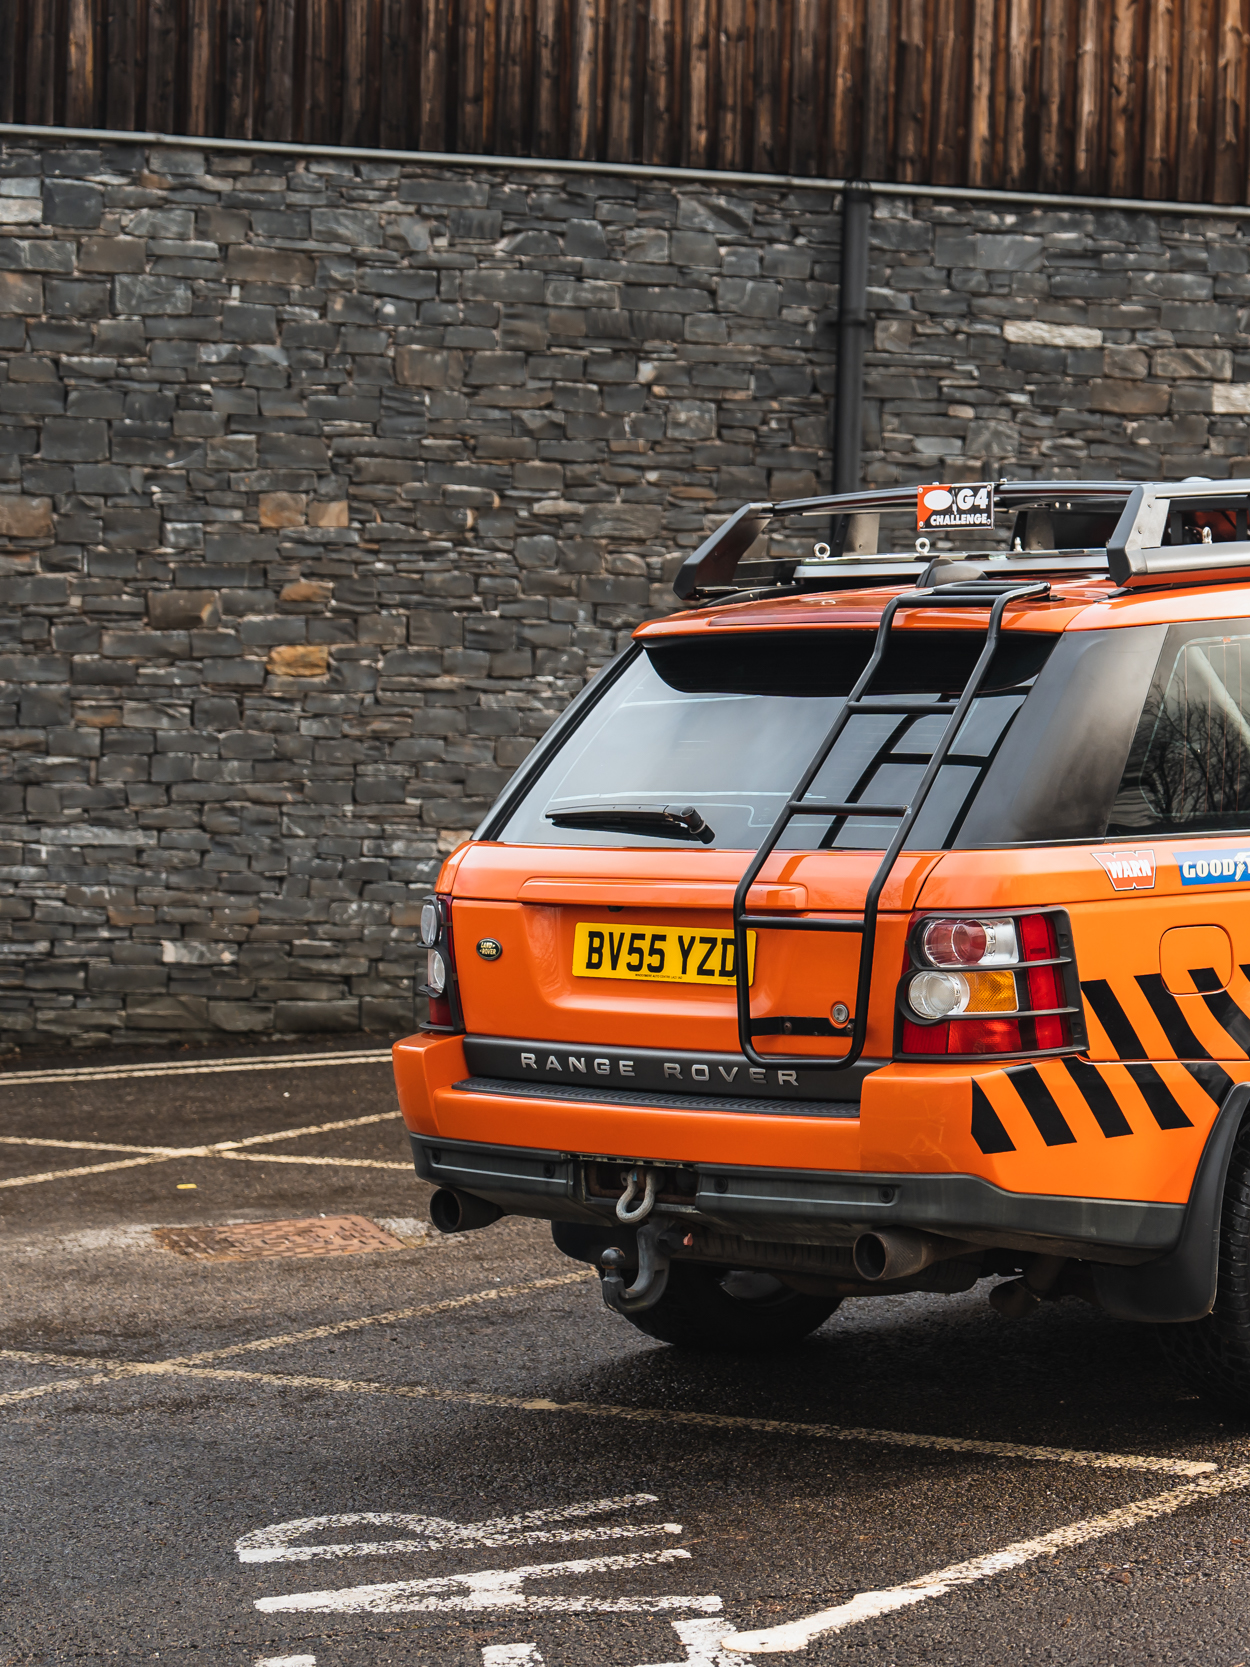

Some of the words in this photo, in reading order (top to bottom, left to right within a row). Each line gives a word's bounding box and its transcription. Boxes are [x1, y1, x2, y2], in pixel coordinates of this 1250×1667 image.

[957, 488, 988, 510] G4
[930, 513, 988, 526] CHALLENGE
[1106, 859, 1152, 879] WARN
[585, 930, 667, 974] BV55
[677, 934, 738, 978] YZD
[520, 1053, 636, 1077] RANGE
[663, 1062, 800, 1086] ROVER
